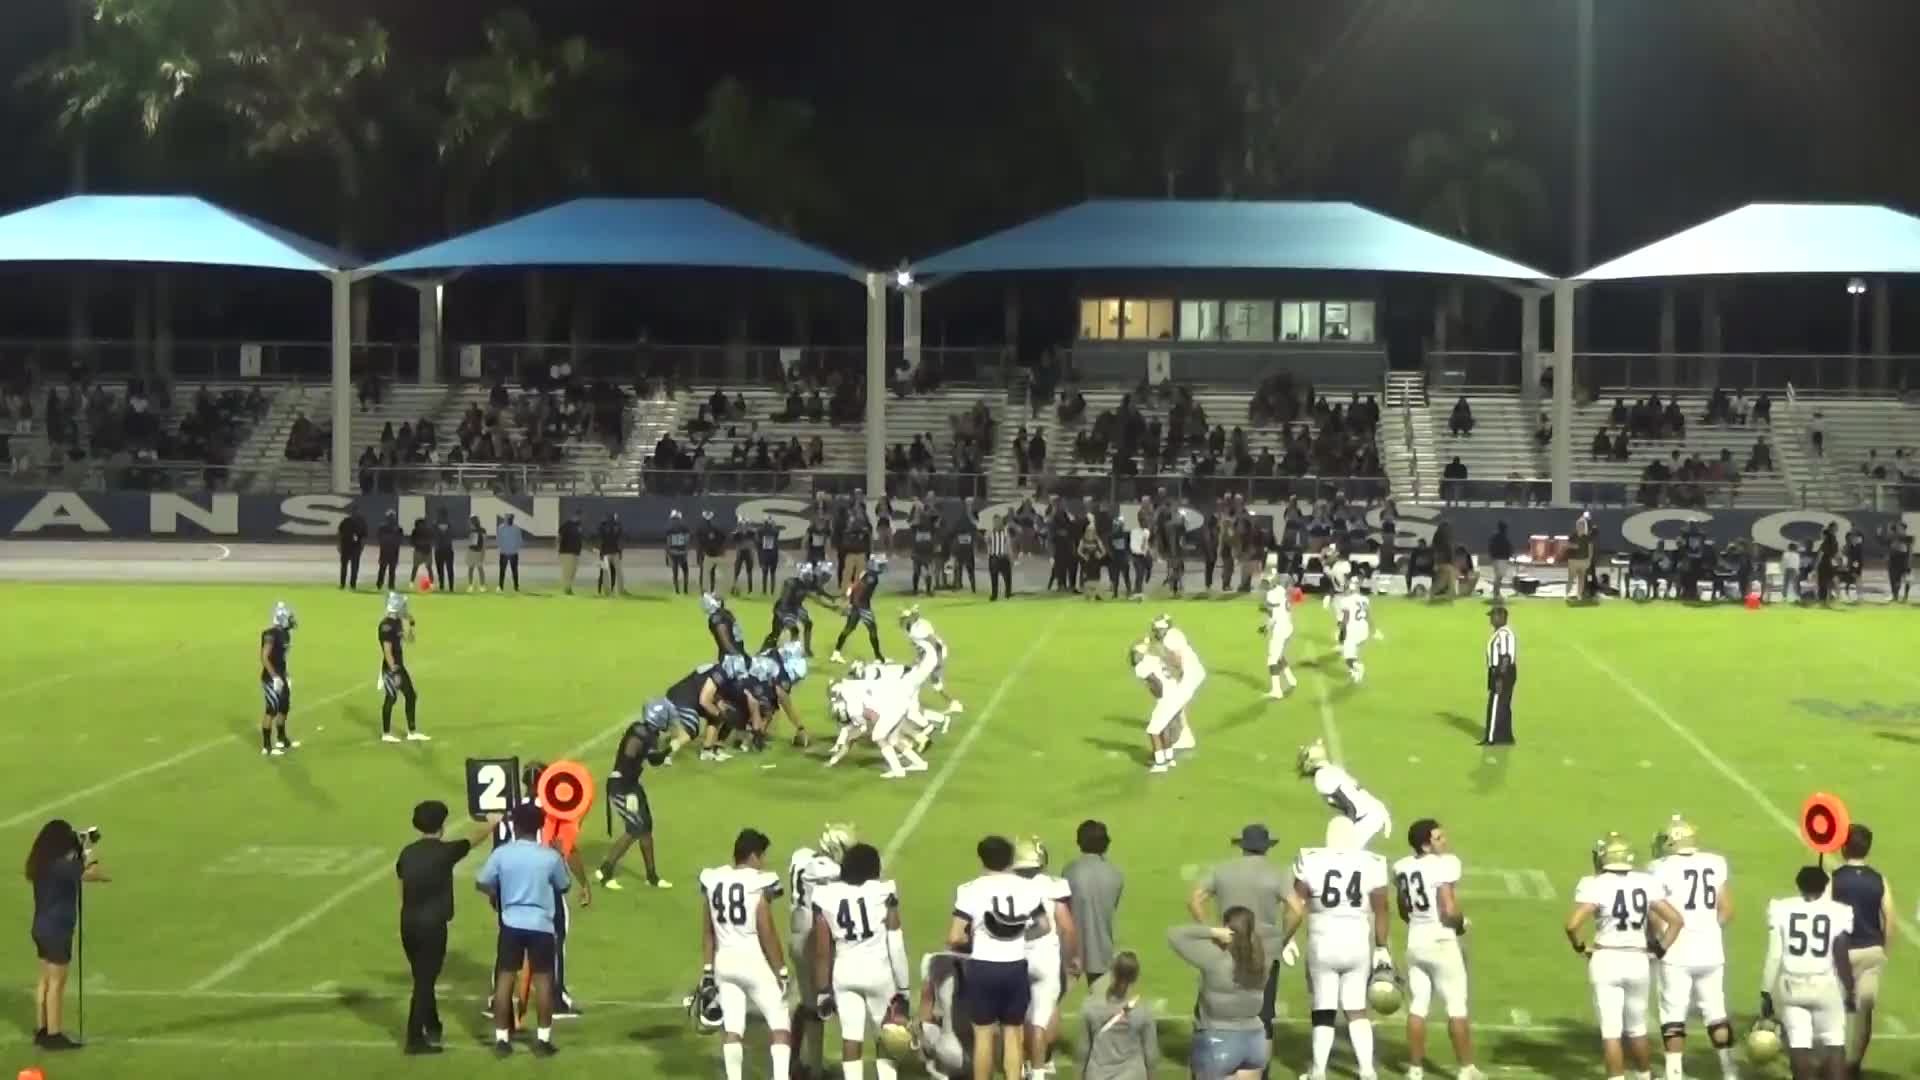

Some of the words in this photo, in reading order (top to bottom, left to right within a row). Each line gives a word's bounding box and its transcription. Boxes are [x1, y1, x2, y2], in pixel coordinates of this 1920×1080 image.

[10, 491, 560, 537] ANSIN
[1622, 508, 1920, 552] CO
[477, 764, 507, 810] 2
[712, 882, 747, 925] 48
[1321, 869, 1363, 909] 64
[1612, 888, 1647, 931] 49
[1684, 868, 1716, 910] 76
[836, 897, 874, 941] 41
[1789, 912, 1831, 958] 59
